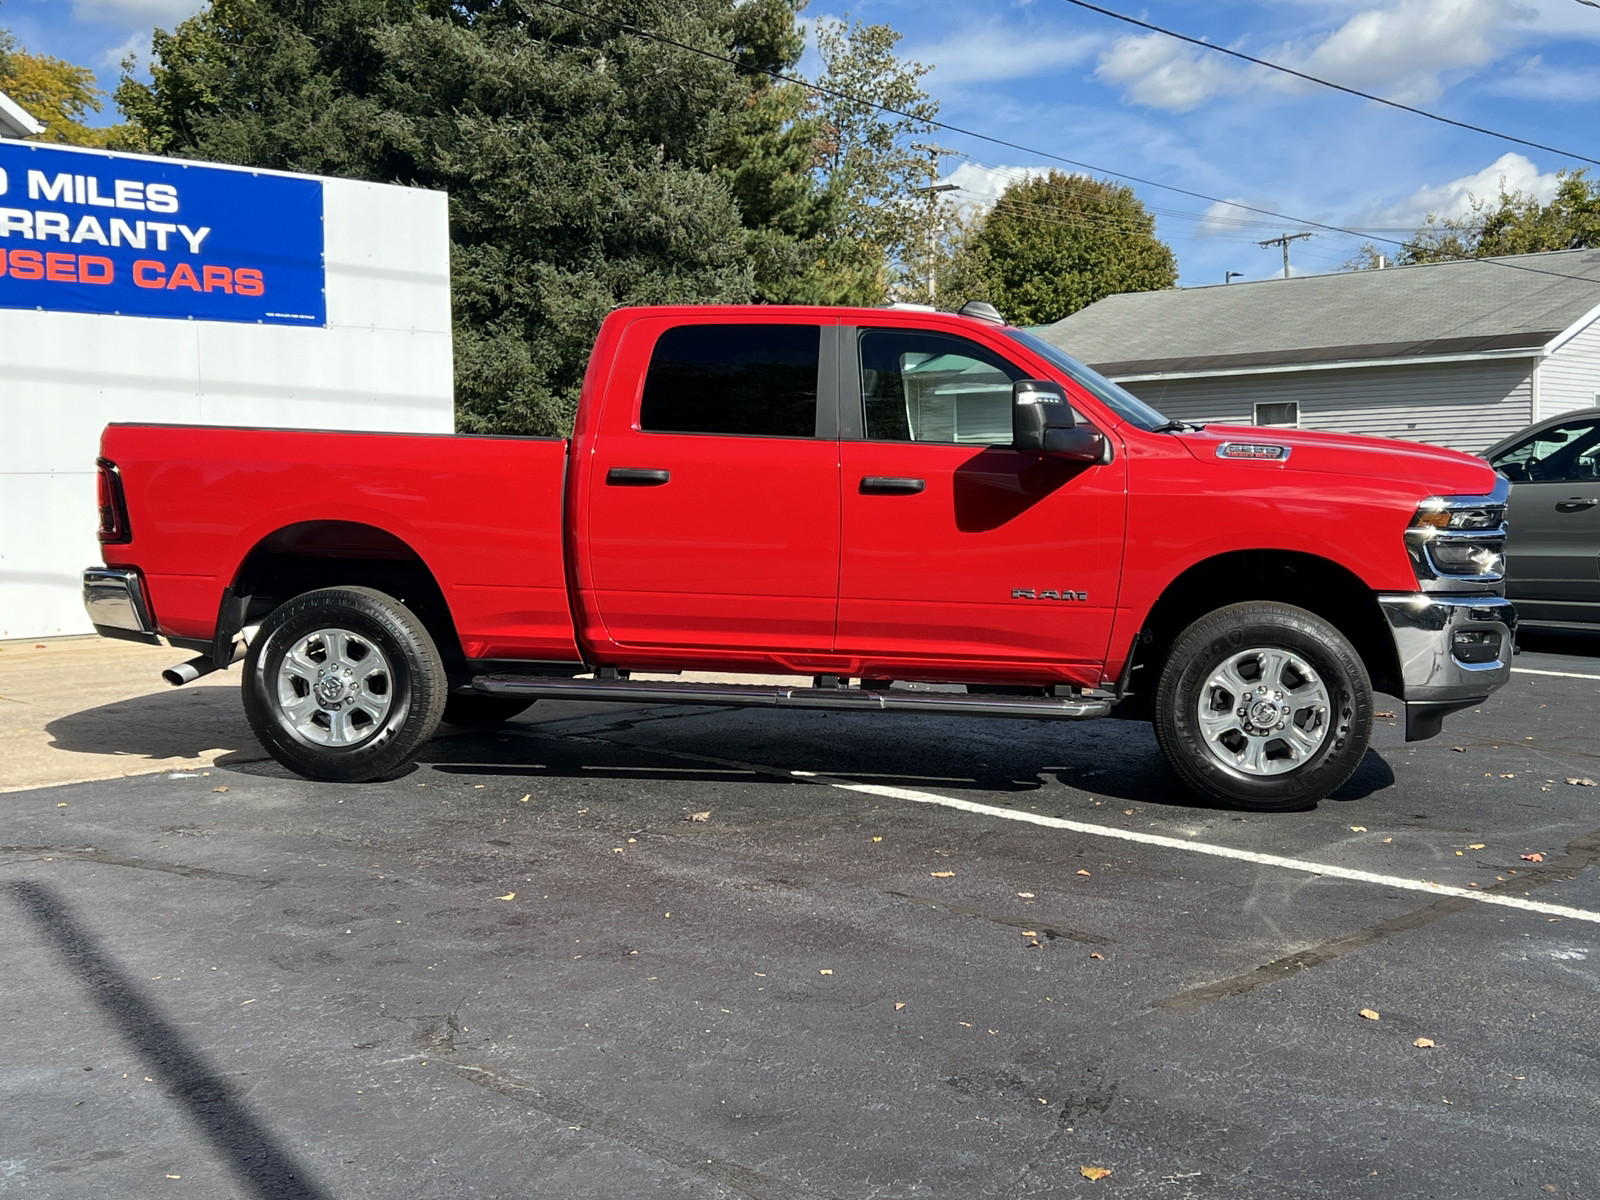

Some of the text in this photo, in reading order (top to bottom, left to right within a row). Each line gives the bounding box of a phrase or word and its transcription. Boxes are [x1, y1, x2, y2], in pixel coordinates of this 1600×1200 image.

[27, 169, 178, 213] MILES
[0, 248, 264, 296] SED CARS
[1011, 588, 1087, 601] RAM
